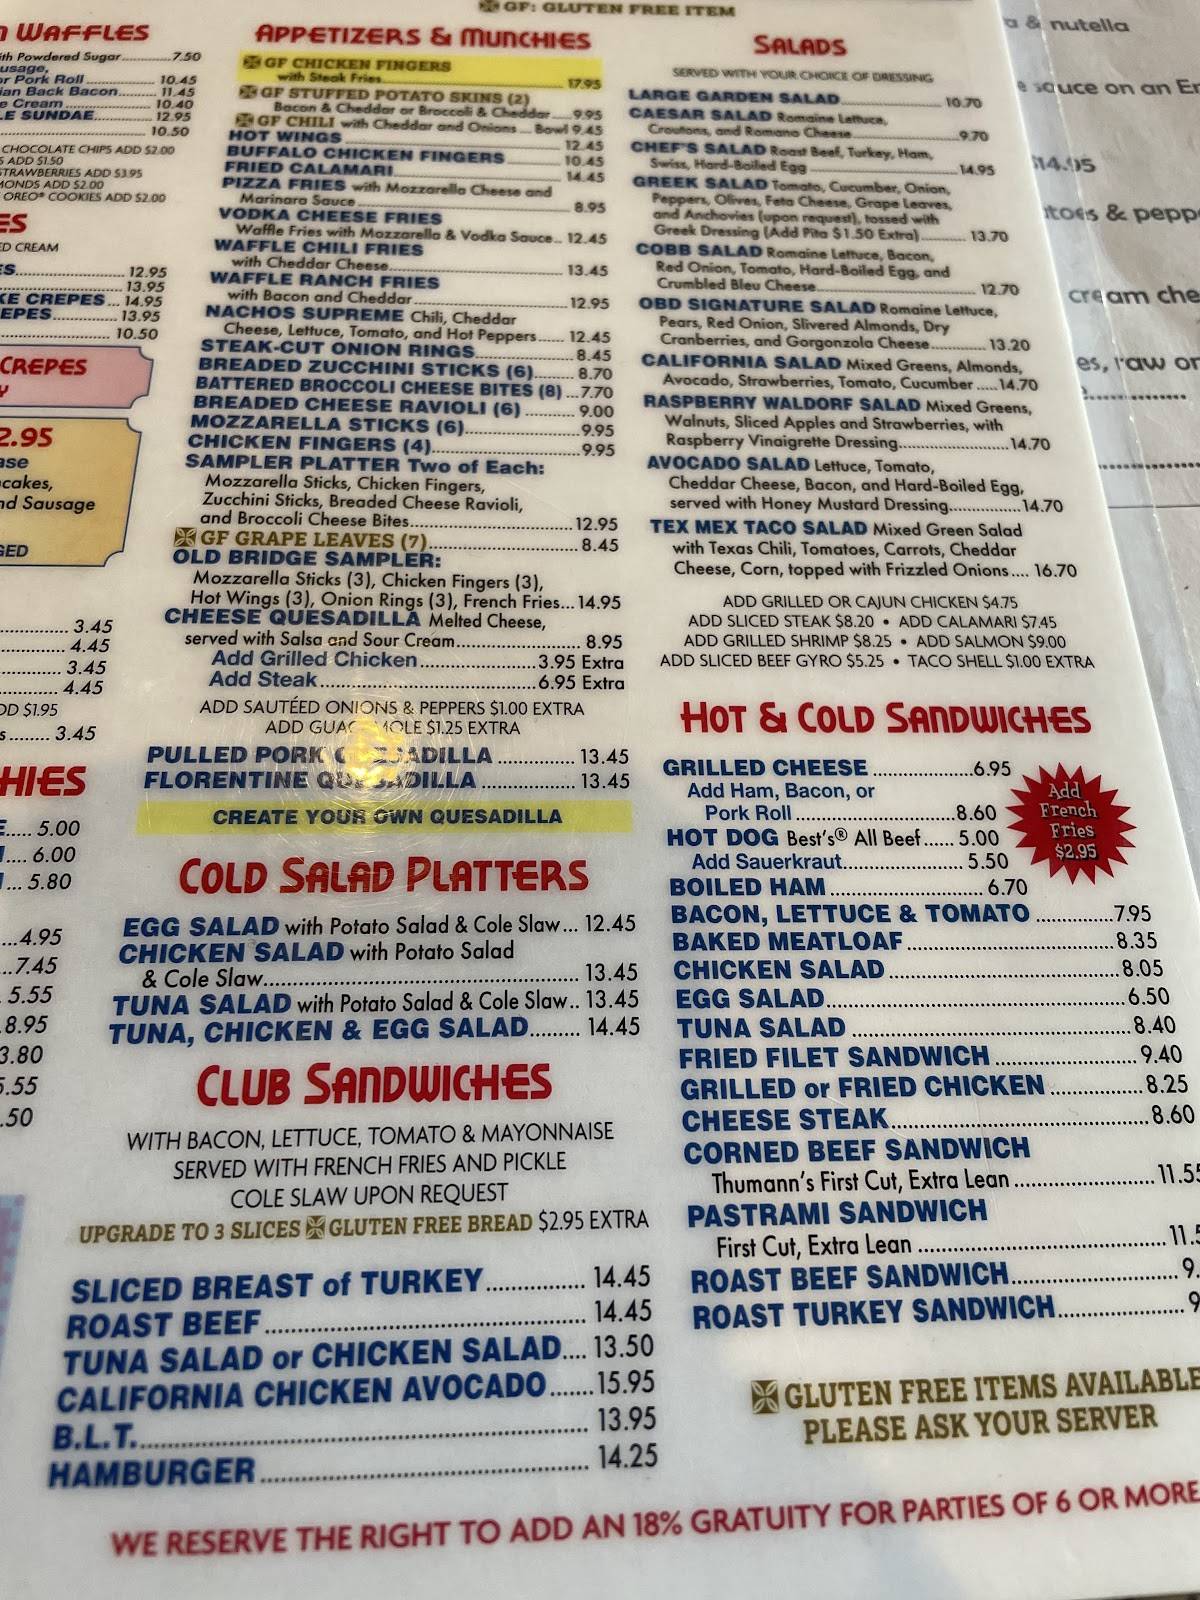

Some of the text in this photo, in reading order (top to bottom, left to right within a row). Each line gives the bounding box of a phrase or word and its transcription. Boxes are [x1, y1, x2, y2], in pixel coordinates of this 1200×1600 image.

[503, 1, 735, 17] GF: GLUTEN FREE ITEM
[16, 23, 149, 42] WAFFLES
[1050, 18, 1130, 32] nutella
[255, 24, 591, 50] APPETIZERS & MUNCHIES
[754, 35, 847, 56] SALADS
[17, 52, 201, 63] Powdered Sugar 7.50
[1104, 83, 1171, 95] on an
[629, 89, 982, 108] LARGE GARDEN SALAD 10.70
[2, 144, 175, 155] CHOCOLATE CHIPS ADD $2.00
[229, 130, 603, 151] HOT WINGS 12.45
[227, 145, 604, 167] BUFFALO CHICKEN FINGERS 10.45
[26, 293, 162, 307] CREPES 14.95
[1069, 290, 1150, 304] cream
[206, 305, 517, 325] NACHOS SUPREME Chili, Cheddar
[660, 333, 1030, 351] Cranberries, and Gorgonzola Cheese 13.20
[0, 356, 87, 375] CREPES
[199, 357, 613, 381] BREADED ZUCCHINI STICKS (6) 8.70
[23, 496, 95, 514] Sausage
[650, 519, 1022, 537] TEX MEX TACO SALAD Mixed Green Salad
[201, 530, 618, 552] GF GRAPE LEAVES (7) 8.45
[723, 595, 1018, 610] ADD GRILLED OR CAJUN CHICKEN $4.75
[74, 619, 113, 633] 3.45
[211, 650, 623, 669] Add Grilled Chicken 3.95 Extra
[23, 702, 58, 717] $1.95
[680, 702, 1091, 733] HOT & COLD SANDWICHES
[663, 759, 1011, 776] GRILLED CHEESE 6.95
[1048, 781, 1080, 800] Add
[213, 809, 563, 825] CREATE YOUR OWN QUESADILLA
[1039, 800, 1097, 817] French
[37, 820, 80, 836] 5.00
[667, 828, 717, 846] HOT
[726, 828, 778, 846] DOG
[854, 829, 877, 846] All
[883, 829, 920, 846] Beef
[959, 830, 999, 846] 5.00
[1050, 822, 1094, 838] Fries
[33, 847, 75, 863] 6.00
[1055, 843, 1096, 860] $2.95
[179, 856, 589, 894] COLD SALAD PLATTERS
[20, 928, 62, 945] 4.95
[673, 931, 1157, 951] BAKED MEATLOAF 8.35
[8, 986, 53, 1004] 5.55
[109, 1016, 640, 1047] TUNA, CHICKEN & EGG SALAD 14.45
[197, 1063, 552, 1106] CLUB SANDWICHES
[174, 1152, 566, 1179] SERVED WITH FRENCH FRIES AND PICKLE
[72, 1265, 650, 1304] SLICED BREAST of TURKEY 14.45
[691, 1262, 1009, 1294] ROAST BEEF SANDWICH
[803, 1404, 1158, 1445] PLEASE ASK YOUR SERVER
[48, 1443, 657, 1488] HAMBURGER 14.25
[112, 1480, 1200, 1557] WE RESERVE THE RIGHT TO ADD AN 18% GRATUITY FOR PARTIES OF 6 OR MORE
